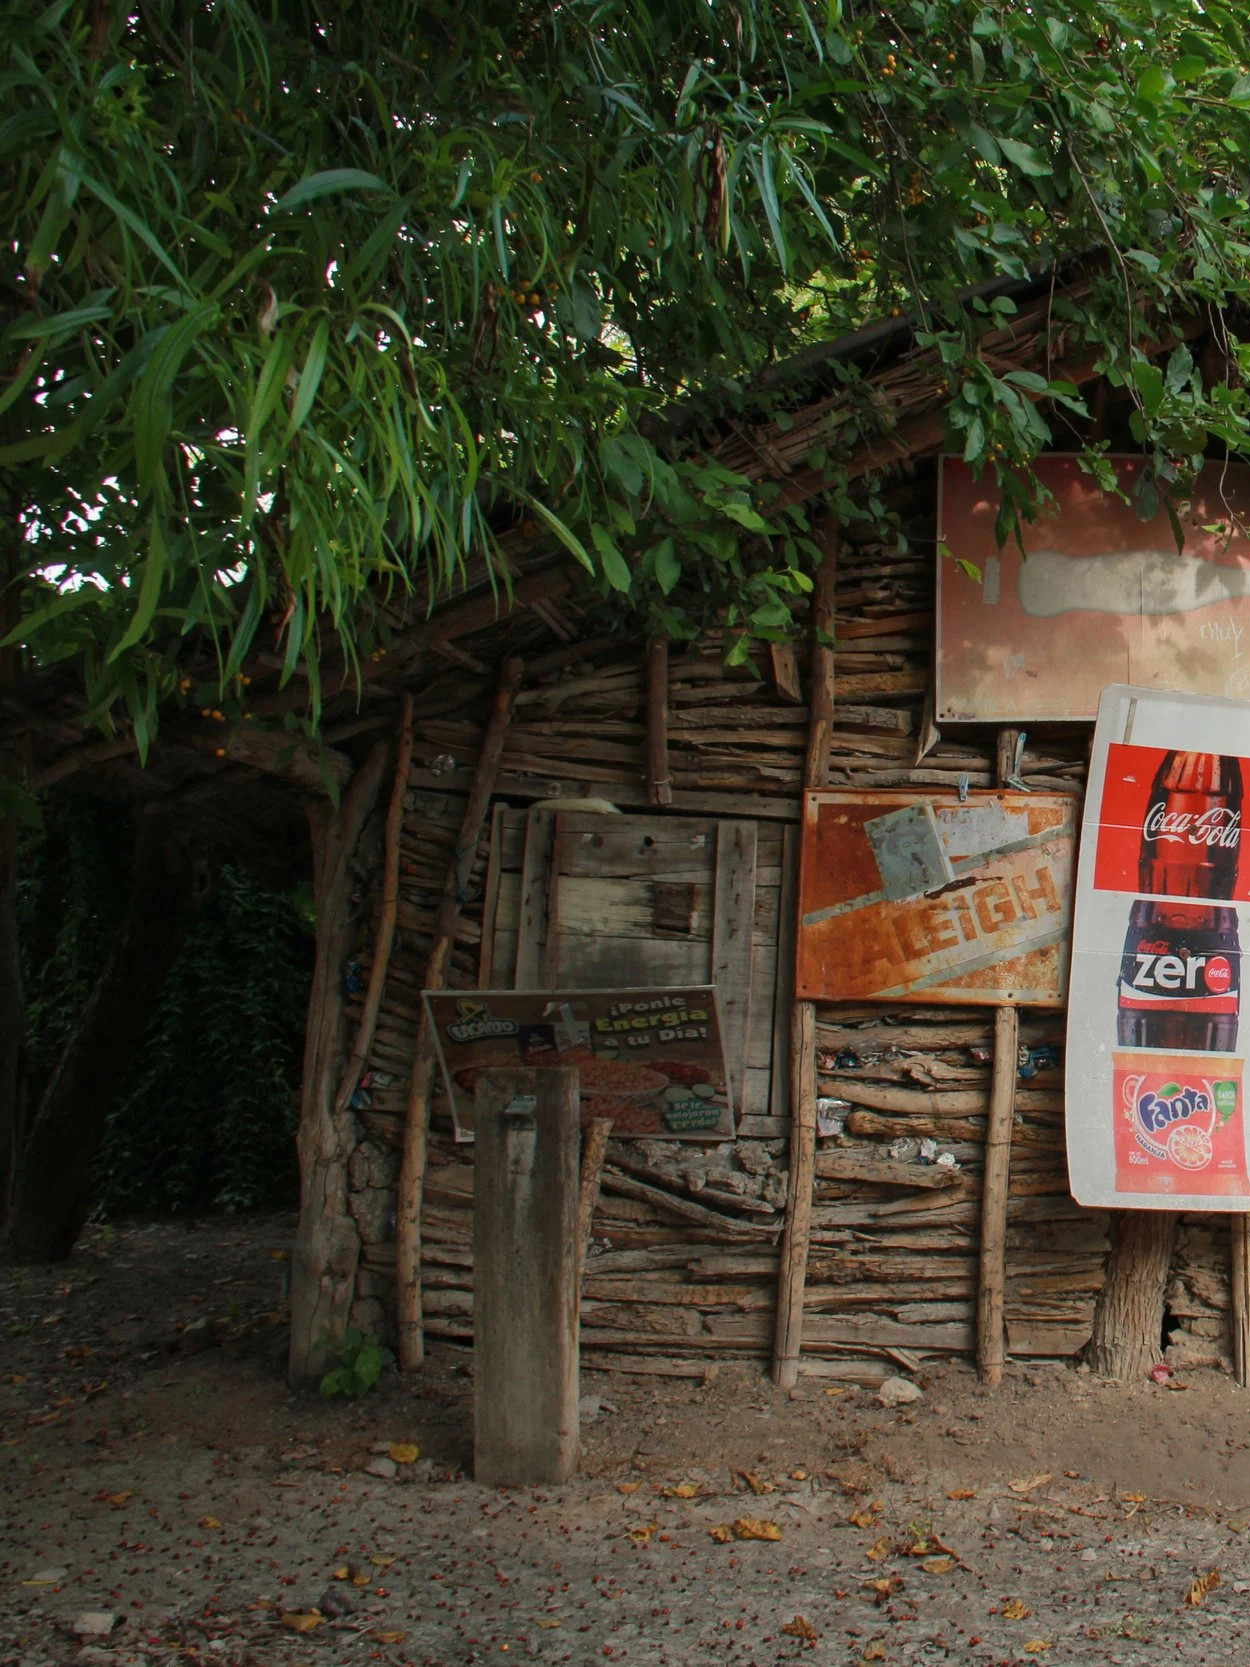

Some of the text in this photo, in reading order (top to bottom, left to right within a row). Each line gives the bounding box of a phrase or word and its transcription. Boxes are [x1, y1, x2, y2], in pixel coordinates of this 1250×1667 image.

[1143, 802, 1242, 848] Coca-Cola
[596, 1007, 708, 1031] Energía
[610, 996, 687, 1017] ¡Ponle
[603, 1027, 708, 1047] a tu Día!
[1138, 1086, 1209, 1133] Fanta
[1136, 1134, 1167, 1160] NARANJA
